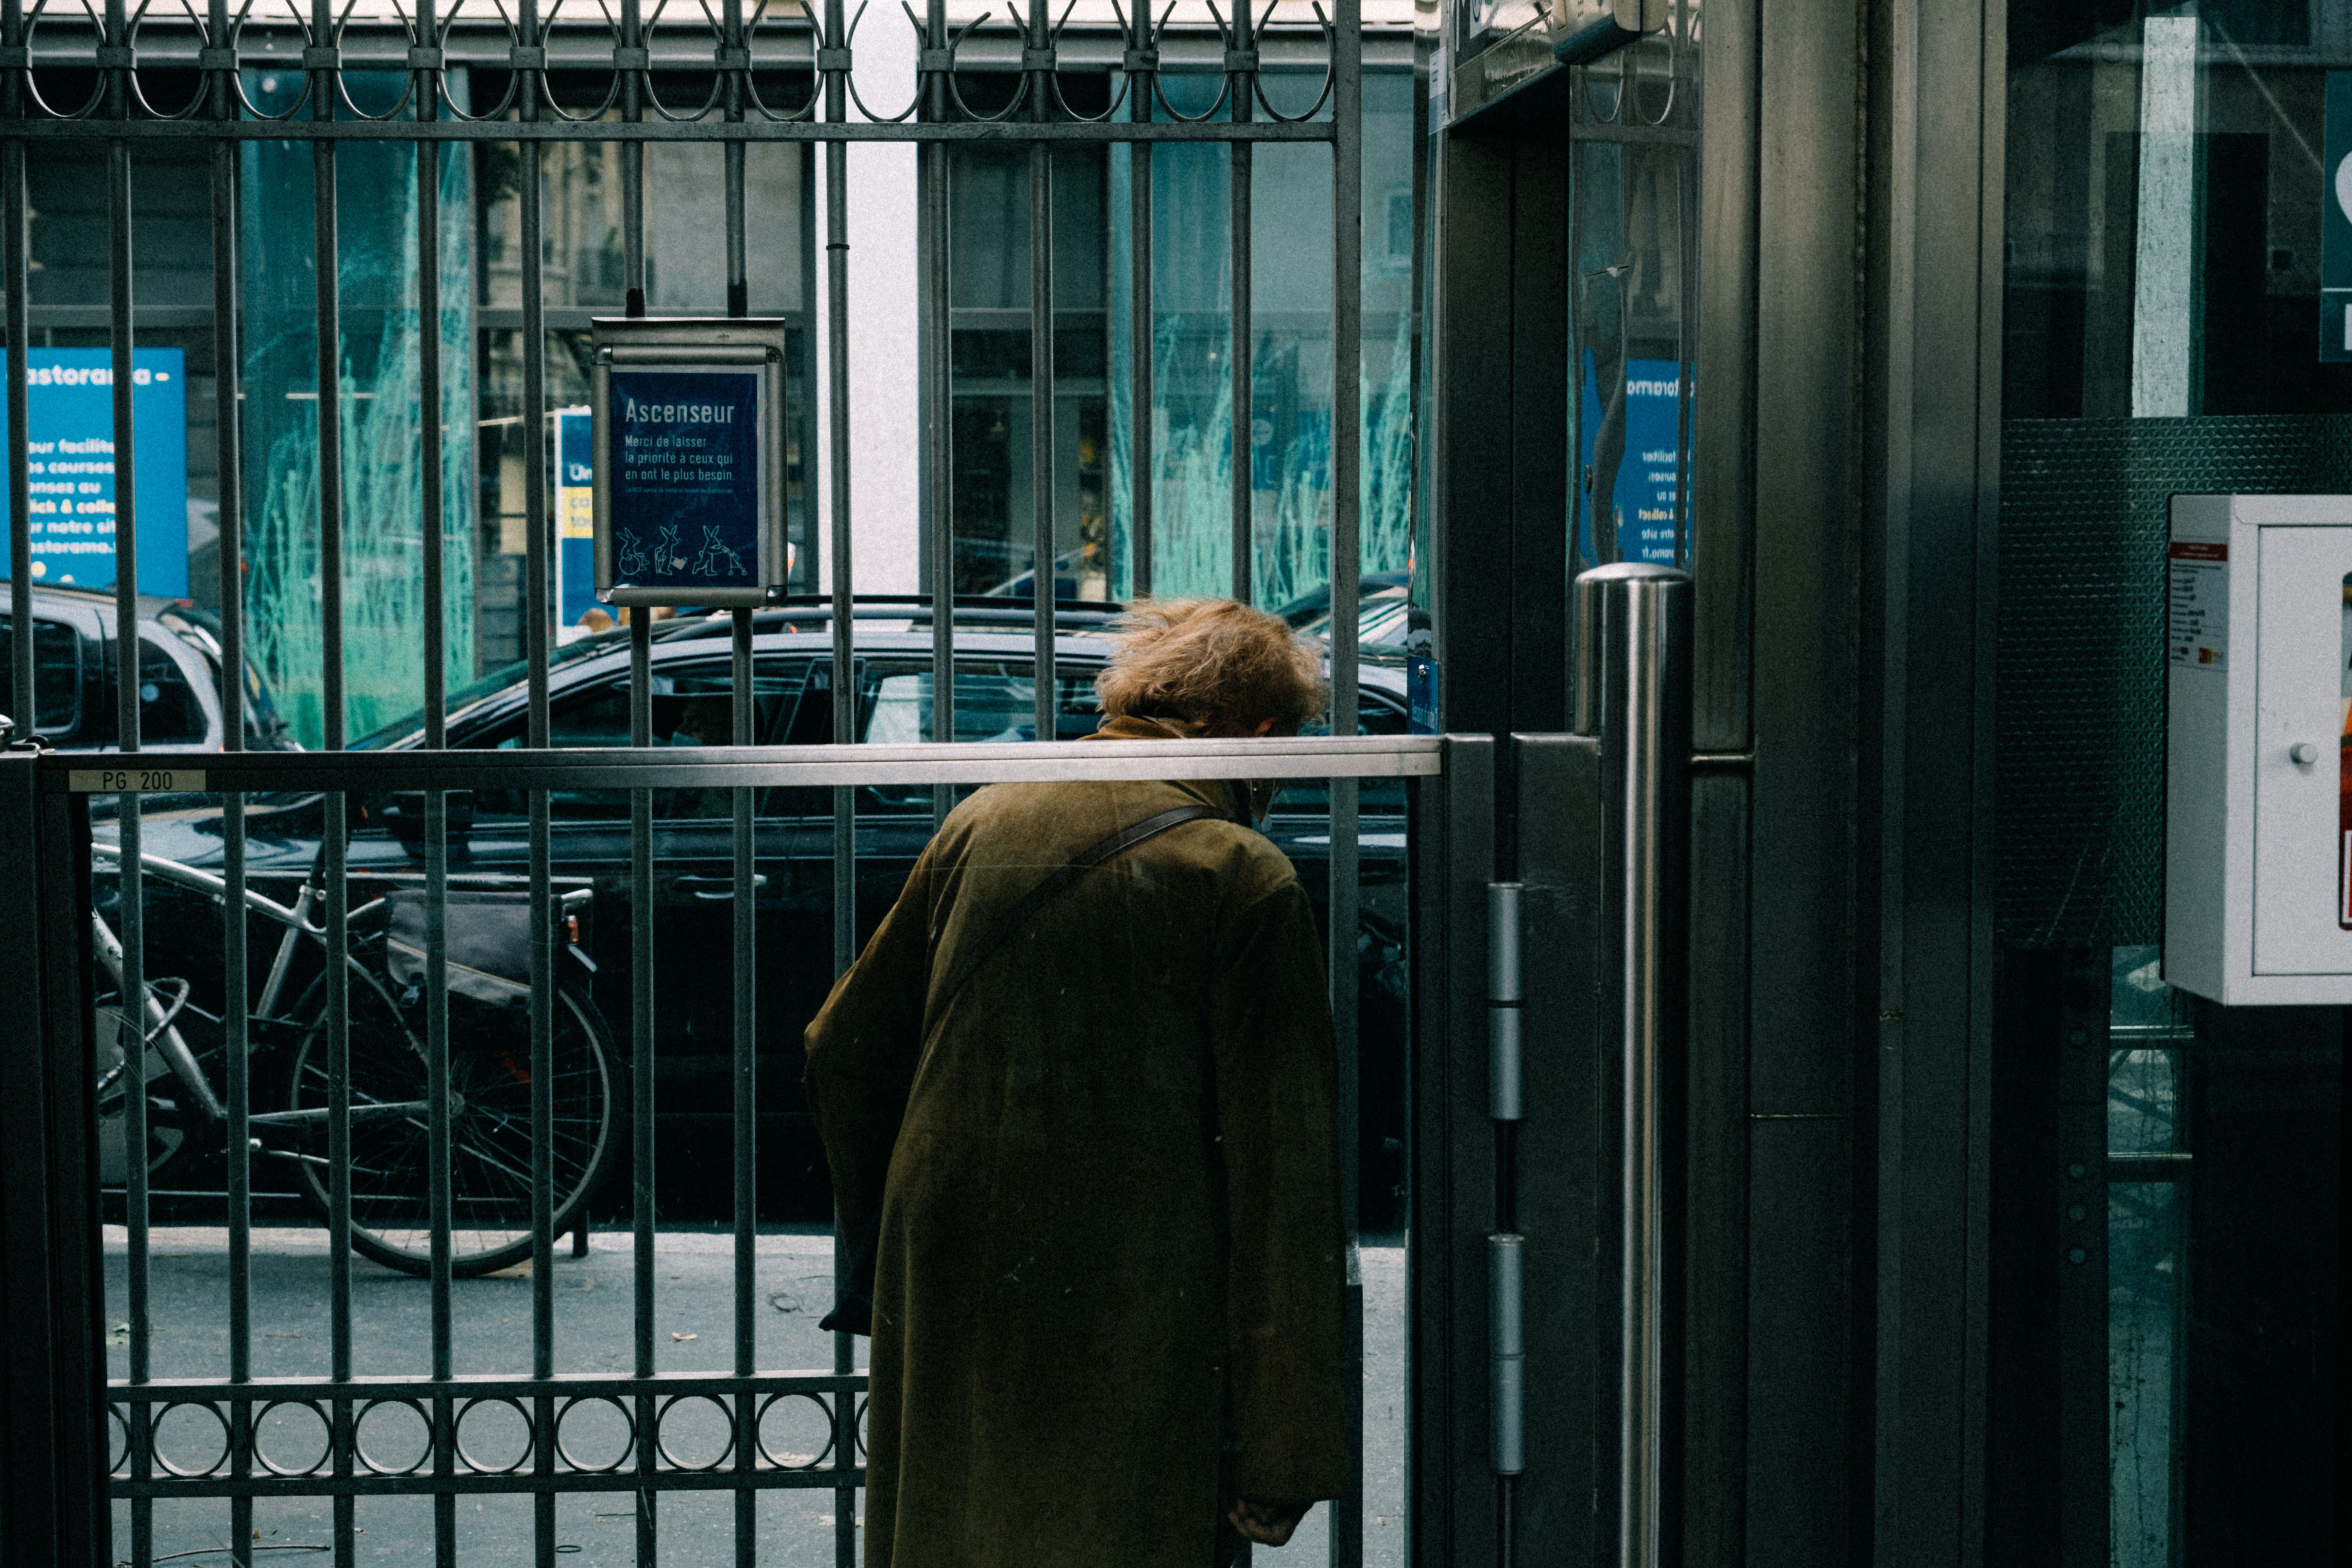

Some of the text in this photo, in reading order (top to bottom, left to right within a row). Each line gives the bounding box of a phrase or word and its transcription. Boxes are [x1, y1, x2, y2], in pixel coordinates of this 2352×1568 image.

[625, 398, 734, 423] Ascenseur
[29, 442, 55, 454] our
[625, 435, 706, 447] Merci de laisser
[625, 452, 733, 467] la priorité à ceux qui
[625, 468, 735, 482] en ont le plus besoin.
[103, 772, 172, 790] PG 200
